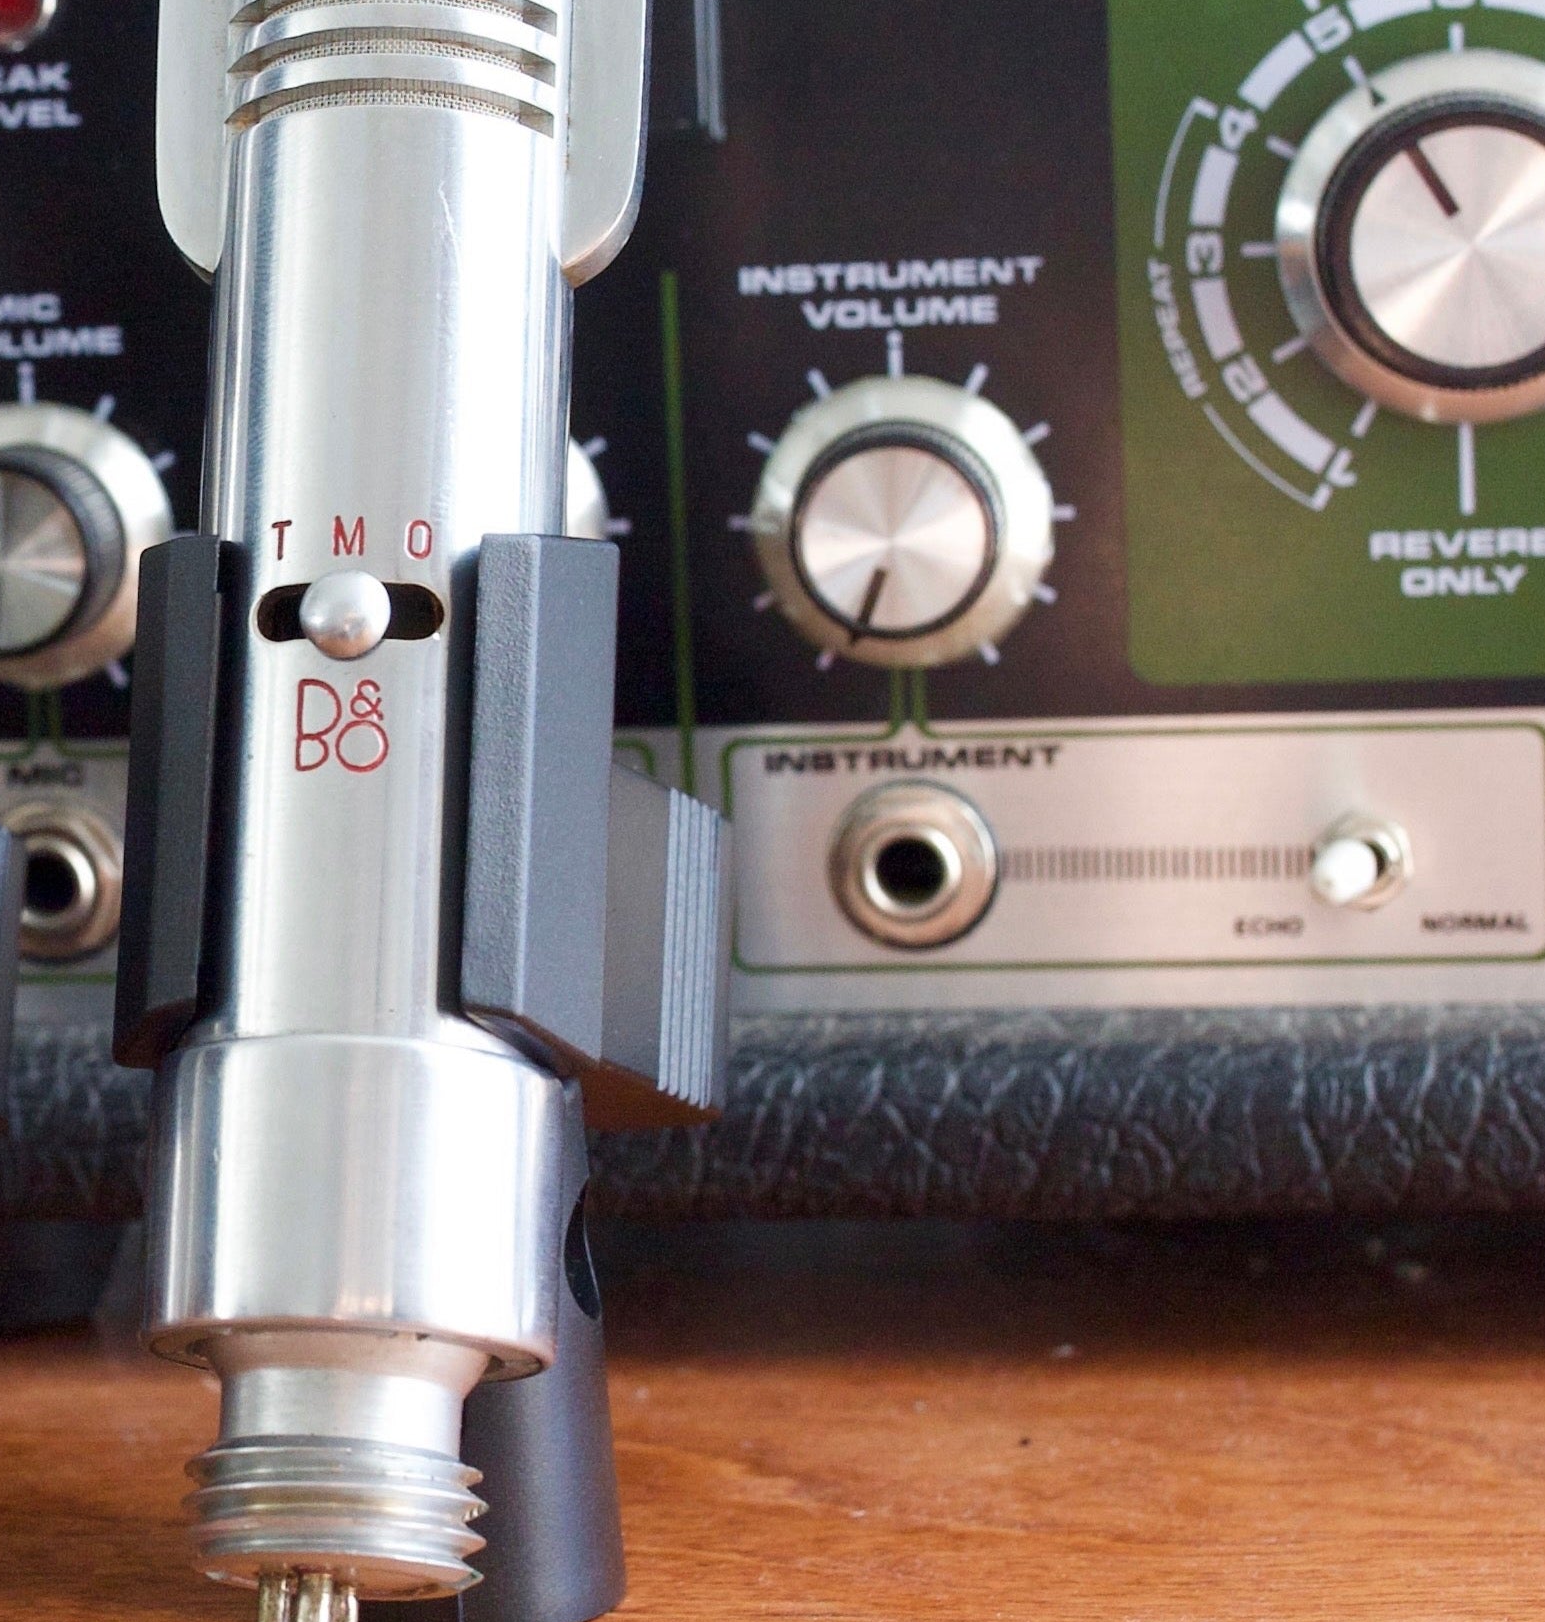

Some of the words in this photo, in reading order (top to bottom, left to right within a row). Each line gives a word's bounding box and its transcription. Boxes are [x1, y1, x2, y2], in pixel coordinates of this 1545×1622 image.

[1304, 4, 1353, 53] 5
[1218, 105, 1259, 149] 4
[1186, 232, 1224, 274] 3
[738, 255, 1044, 295] INSTRUMENT
[802, 295, 1000, 329] VOLUME
[1147, 258, 1208, 400] REPEAT
[272, 520, 292, 560] T
[333, 516, 363, 556] M
[1401, 564, 1528, 597] ONLY
[764, 746, 1058, 773] INSTRUMENT
